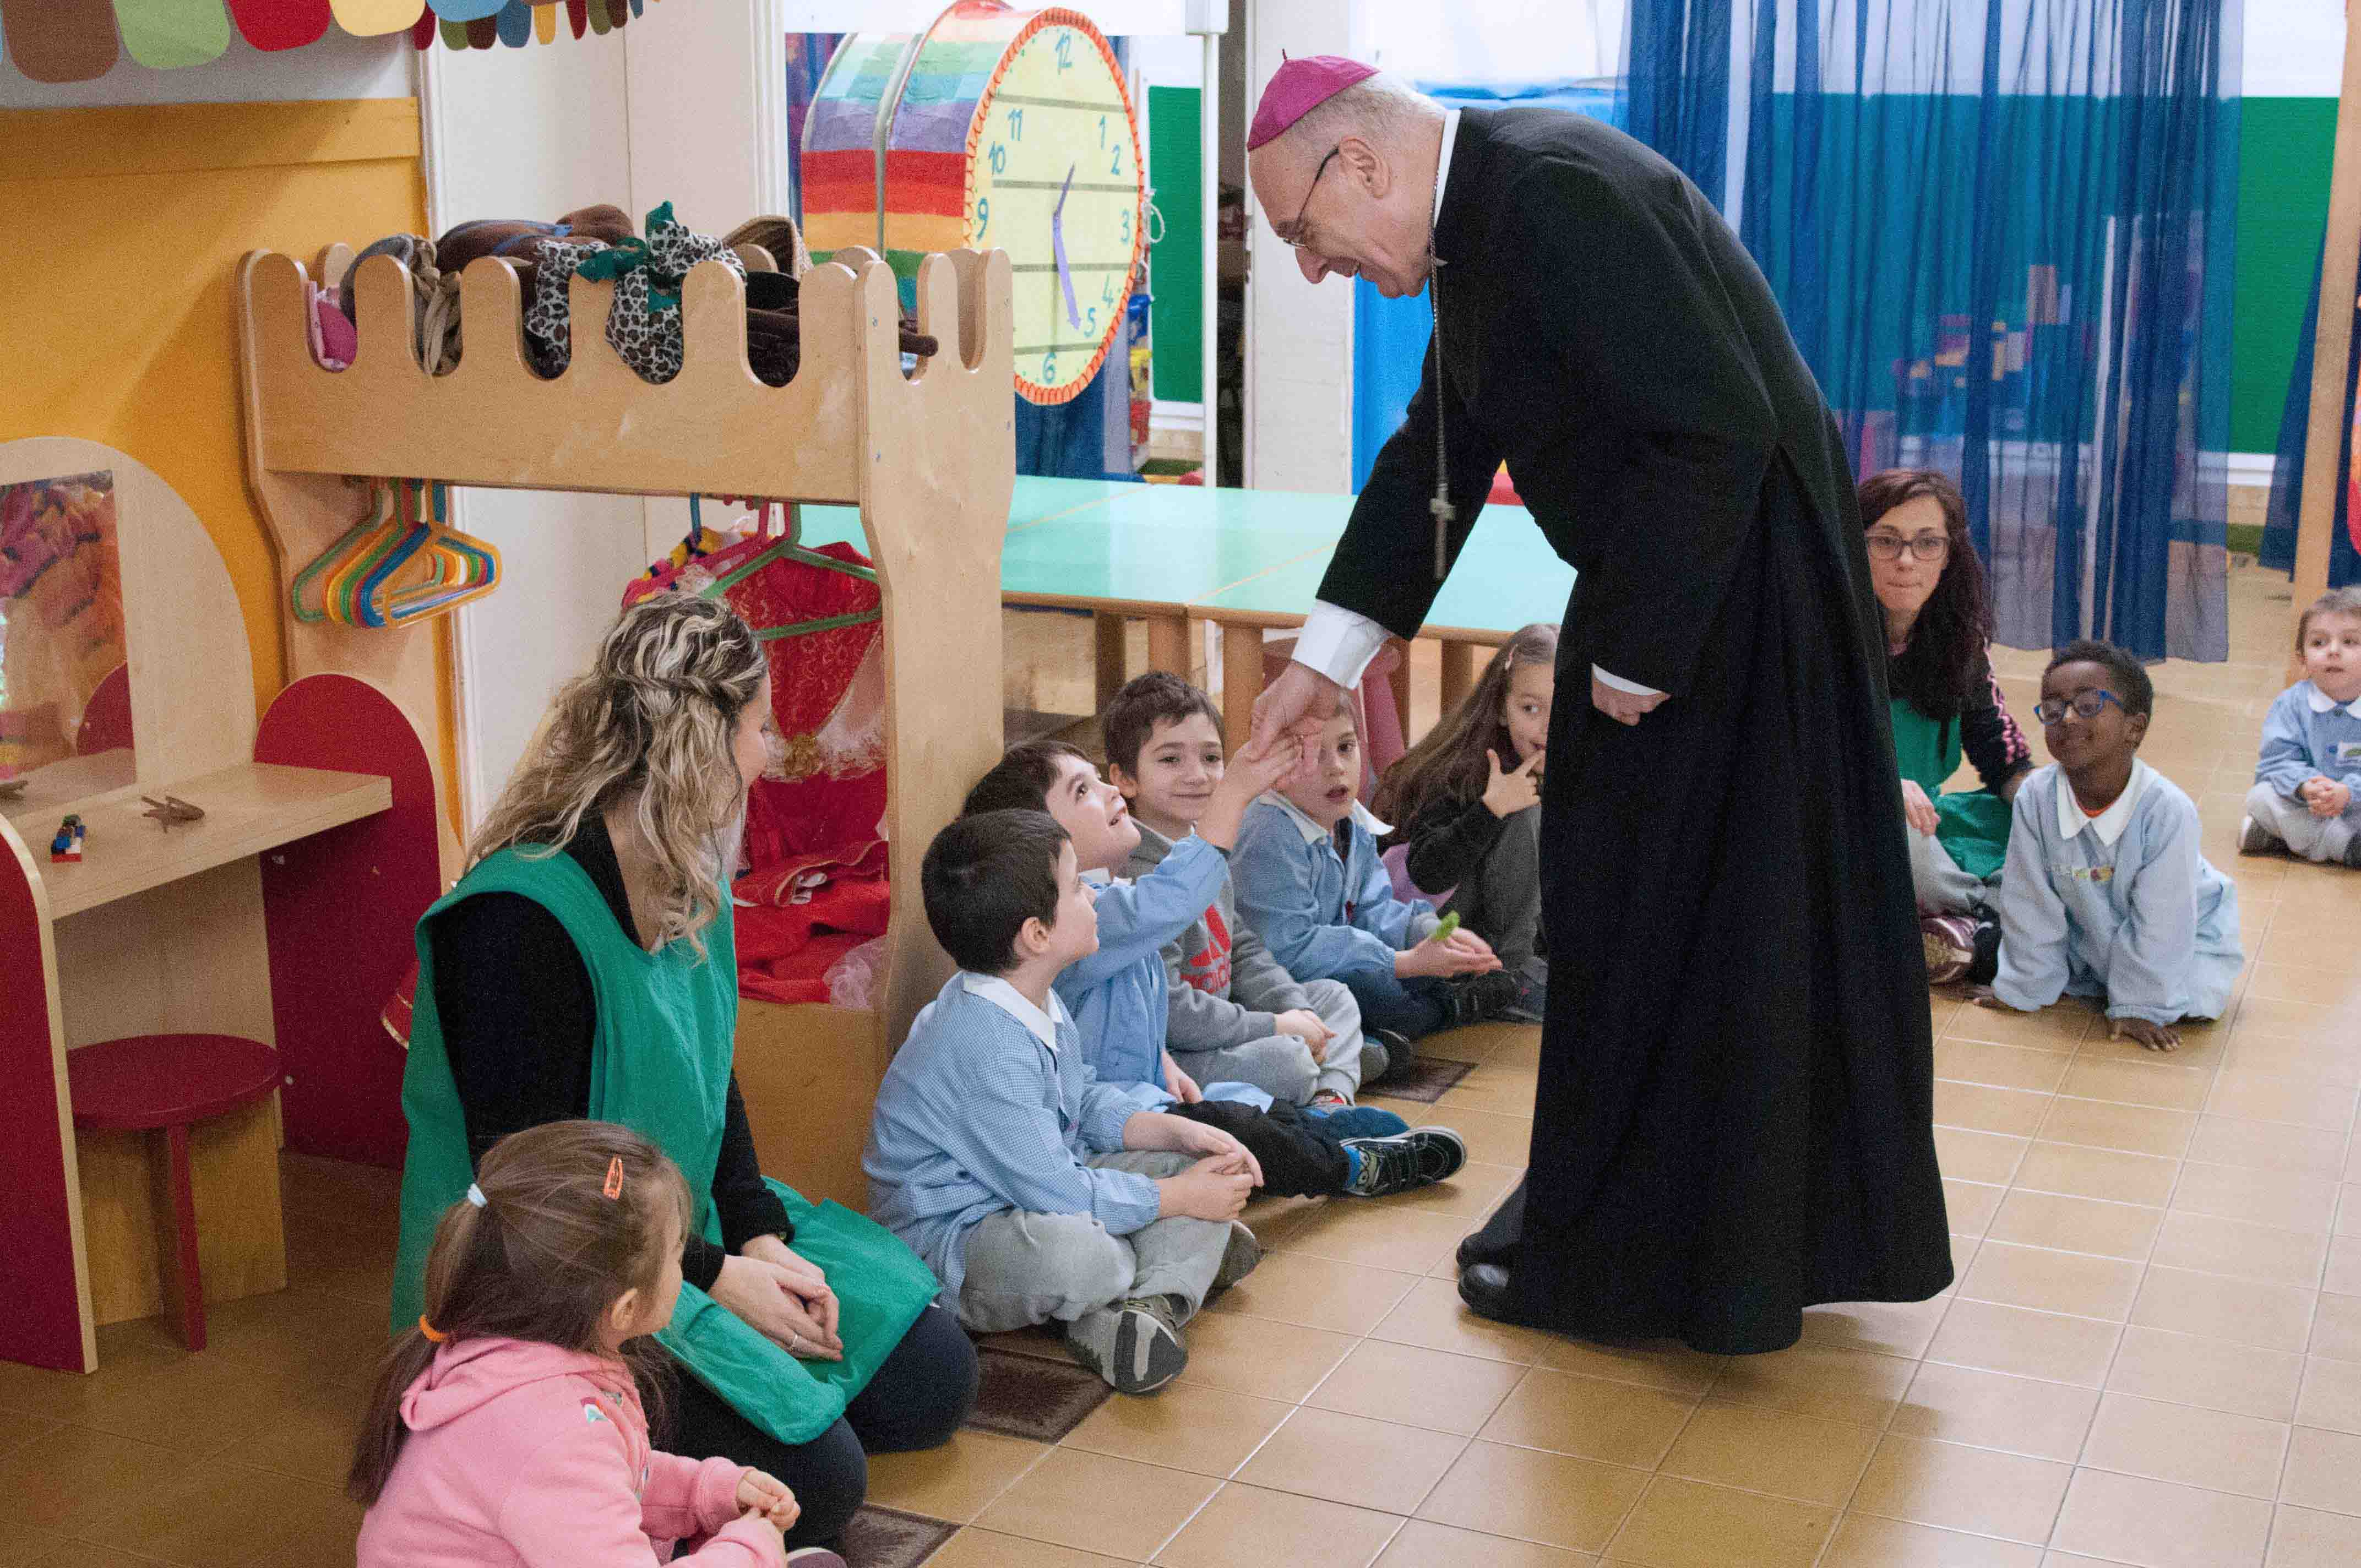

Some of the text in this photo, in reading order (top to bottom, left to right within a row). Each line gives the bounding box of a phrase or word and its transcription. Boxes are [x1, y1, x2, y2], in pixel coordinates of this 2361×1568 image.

[1054, 33, 1073, 75] 12
[1008, 109, 1022, 141] 11
[1099, 115, 1106, 149] 1
[989, 141, 1005, 175] 10
[1111, 144, 1120, 176] 2
[977, 197, 989, 241] 9
[1120, 209, 1131, 243] 3
[1102, 273, 1114, 308] 4
[1084, 307, 1096, 337] 5
[1043, 351, 1057, 384] 6
